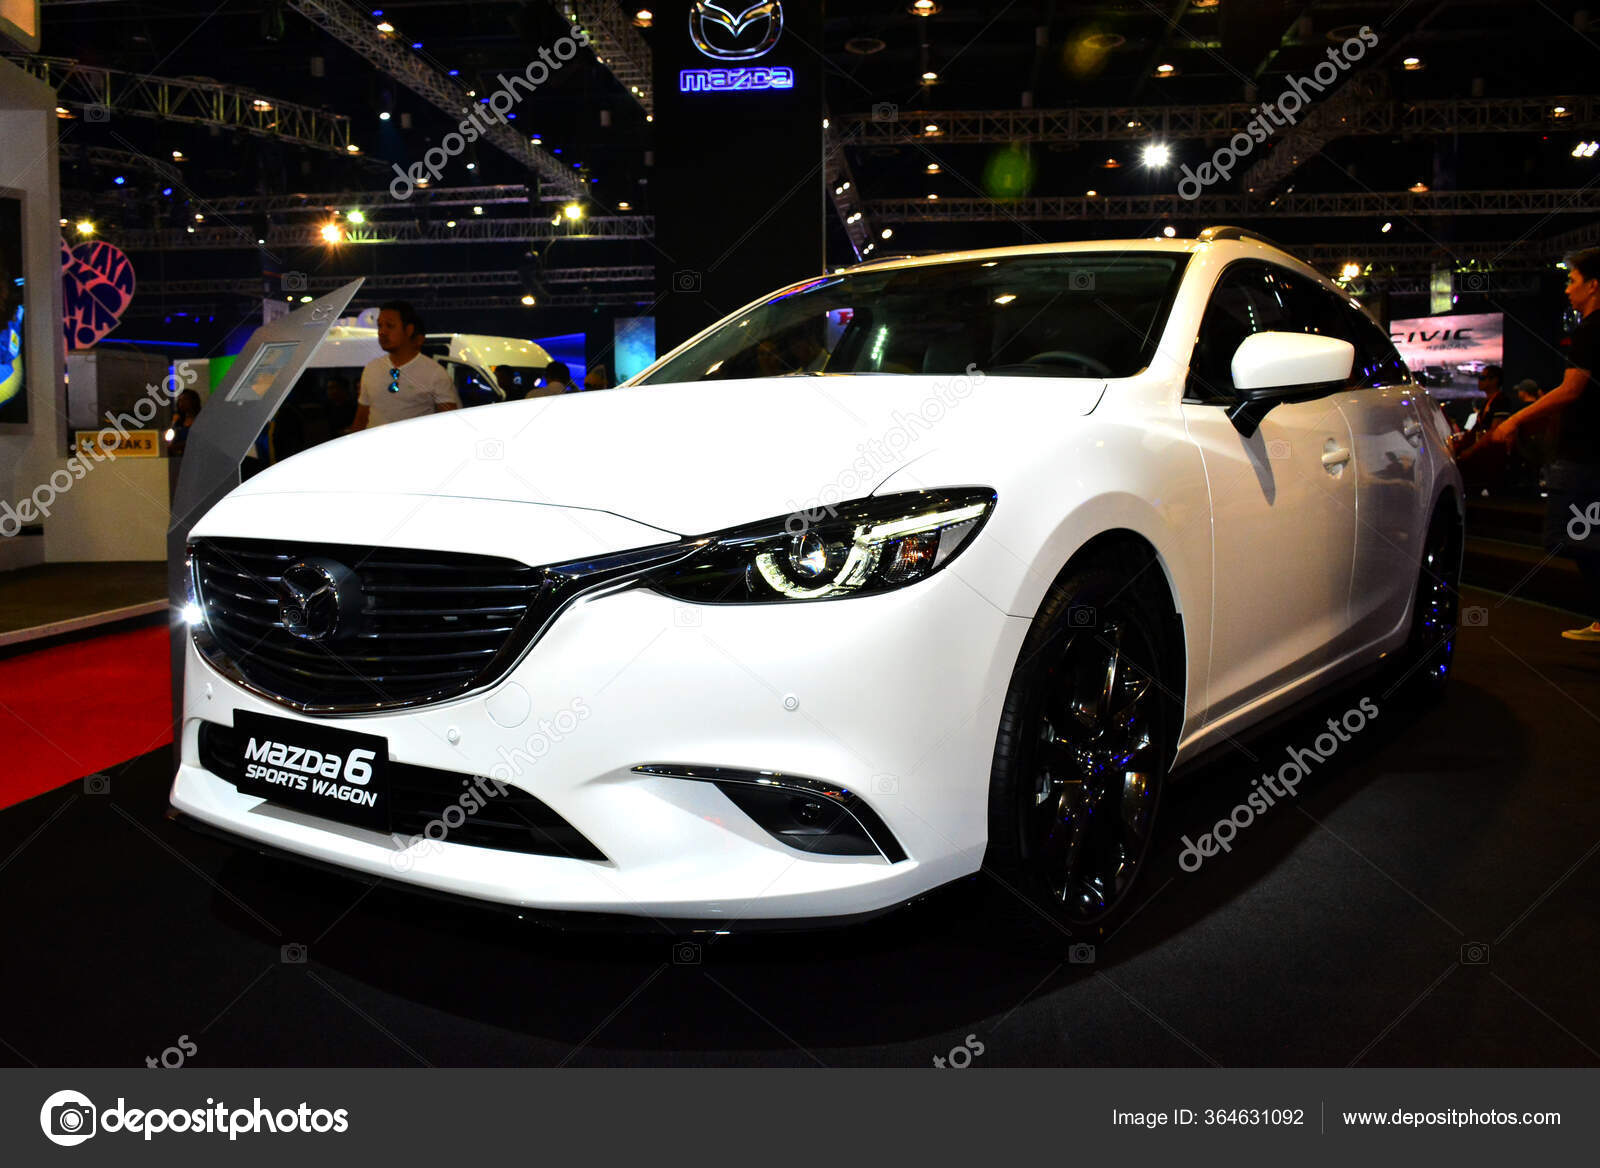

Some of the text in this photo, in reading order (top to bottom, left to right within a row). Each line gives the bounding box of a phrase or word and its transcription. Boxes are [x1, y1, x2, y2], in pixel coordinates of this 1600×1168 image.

[145, 438, 152, 450] 3
[245, 764, 377, 807] SPORTS WAGON
